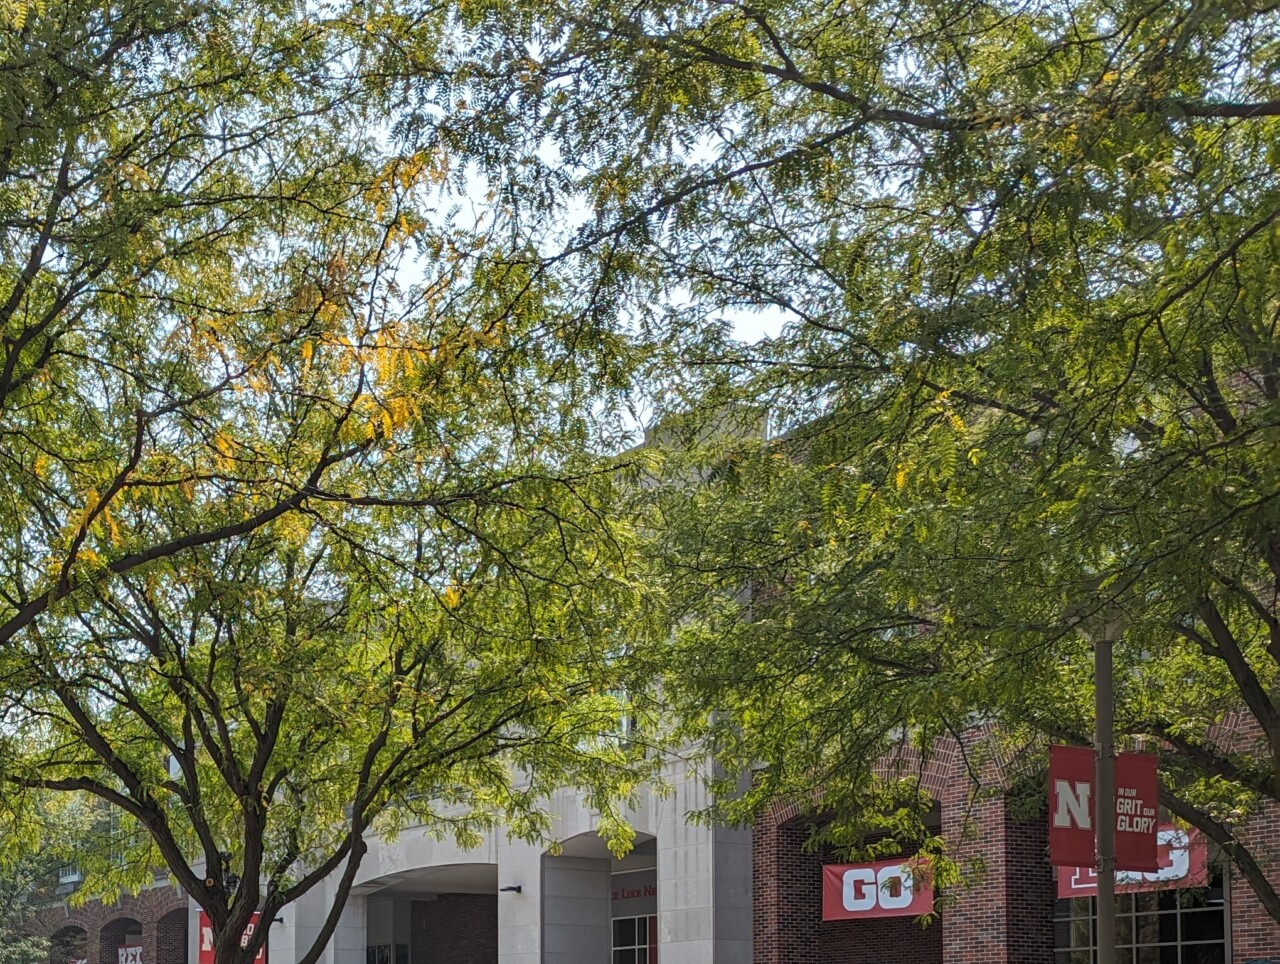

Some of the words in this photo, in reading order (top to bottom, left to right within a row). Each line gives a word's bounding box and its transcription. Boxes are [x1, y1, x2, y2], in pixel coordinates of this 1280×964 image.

[1118, 787, 1125, 796] IN
[1125, 787, 1137, 797] OUR
[1052, 779, 1091, 830] N
[1116, 798, 1144, 816] GRIT
[1143, 807, 1155, 817] OUR
[1116, 815, 1157, 834] GLORY
[842, 864, 913, 912] GO
